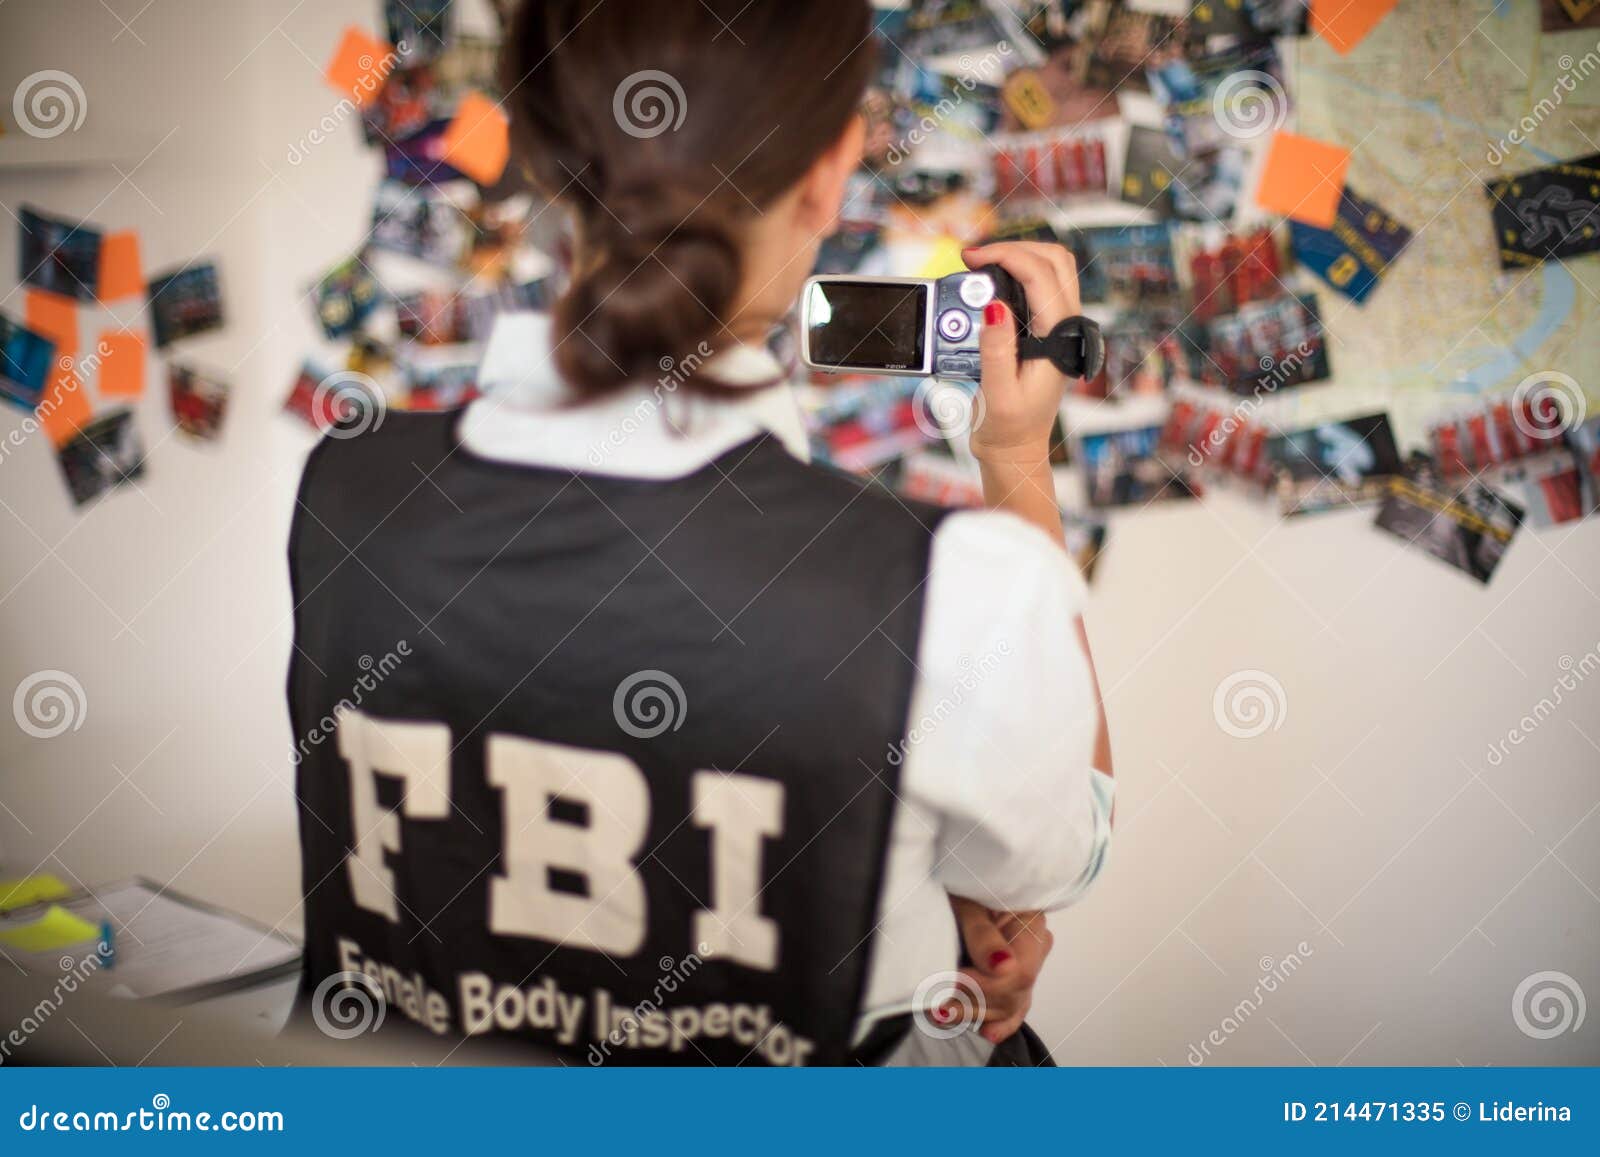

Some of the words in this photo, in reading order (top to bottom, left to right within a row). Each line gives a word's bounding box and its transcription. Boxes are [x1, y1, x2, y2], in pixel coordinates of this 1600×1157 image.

[337, 706, 784, 972] FBI
[458, 973, 584, 1044] Body
[594, 988, 815, 1066] Inspector
